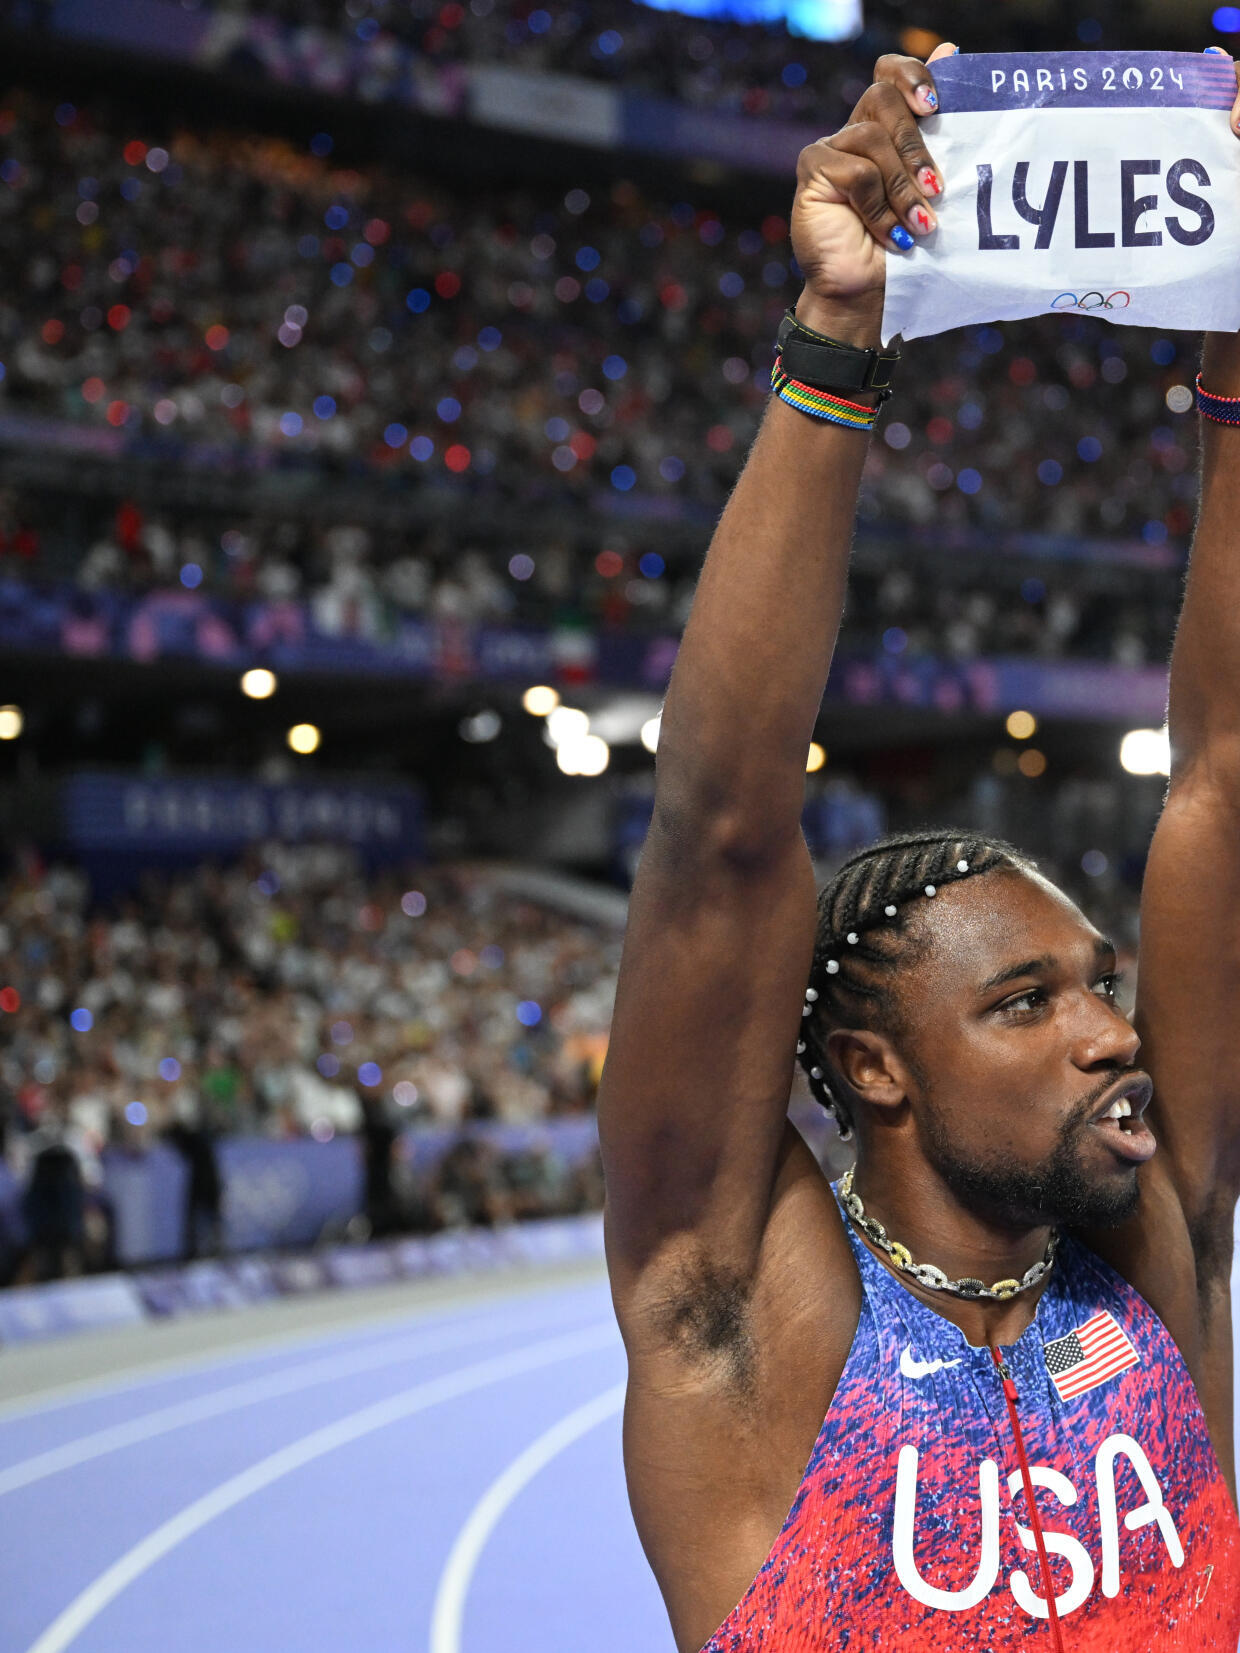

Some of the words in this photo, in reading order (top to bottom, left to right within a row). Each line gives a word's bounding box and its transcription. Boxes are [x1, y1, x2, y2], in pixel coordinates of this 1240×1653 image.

[1102, 67, 1184, 90] 2024
[976, 158, 1215, 250] LYLES
[892, 1433, 1185, 1619] USA
